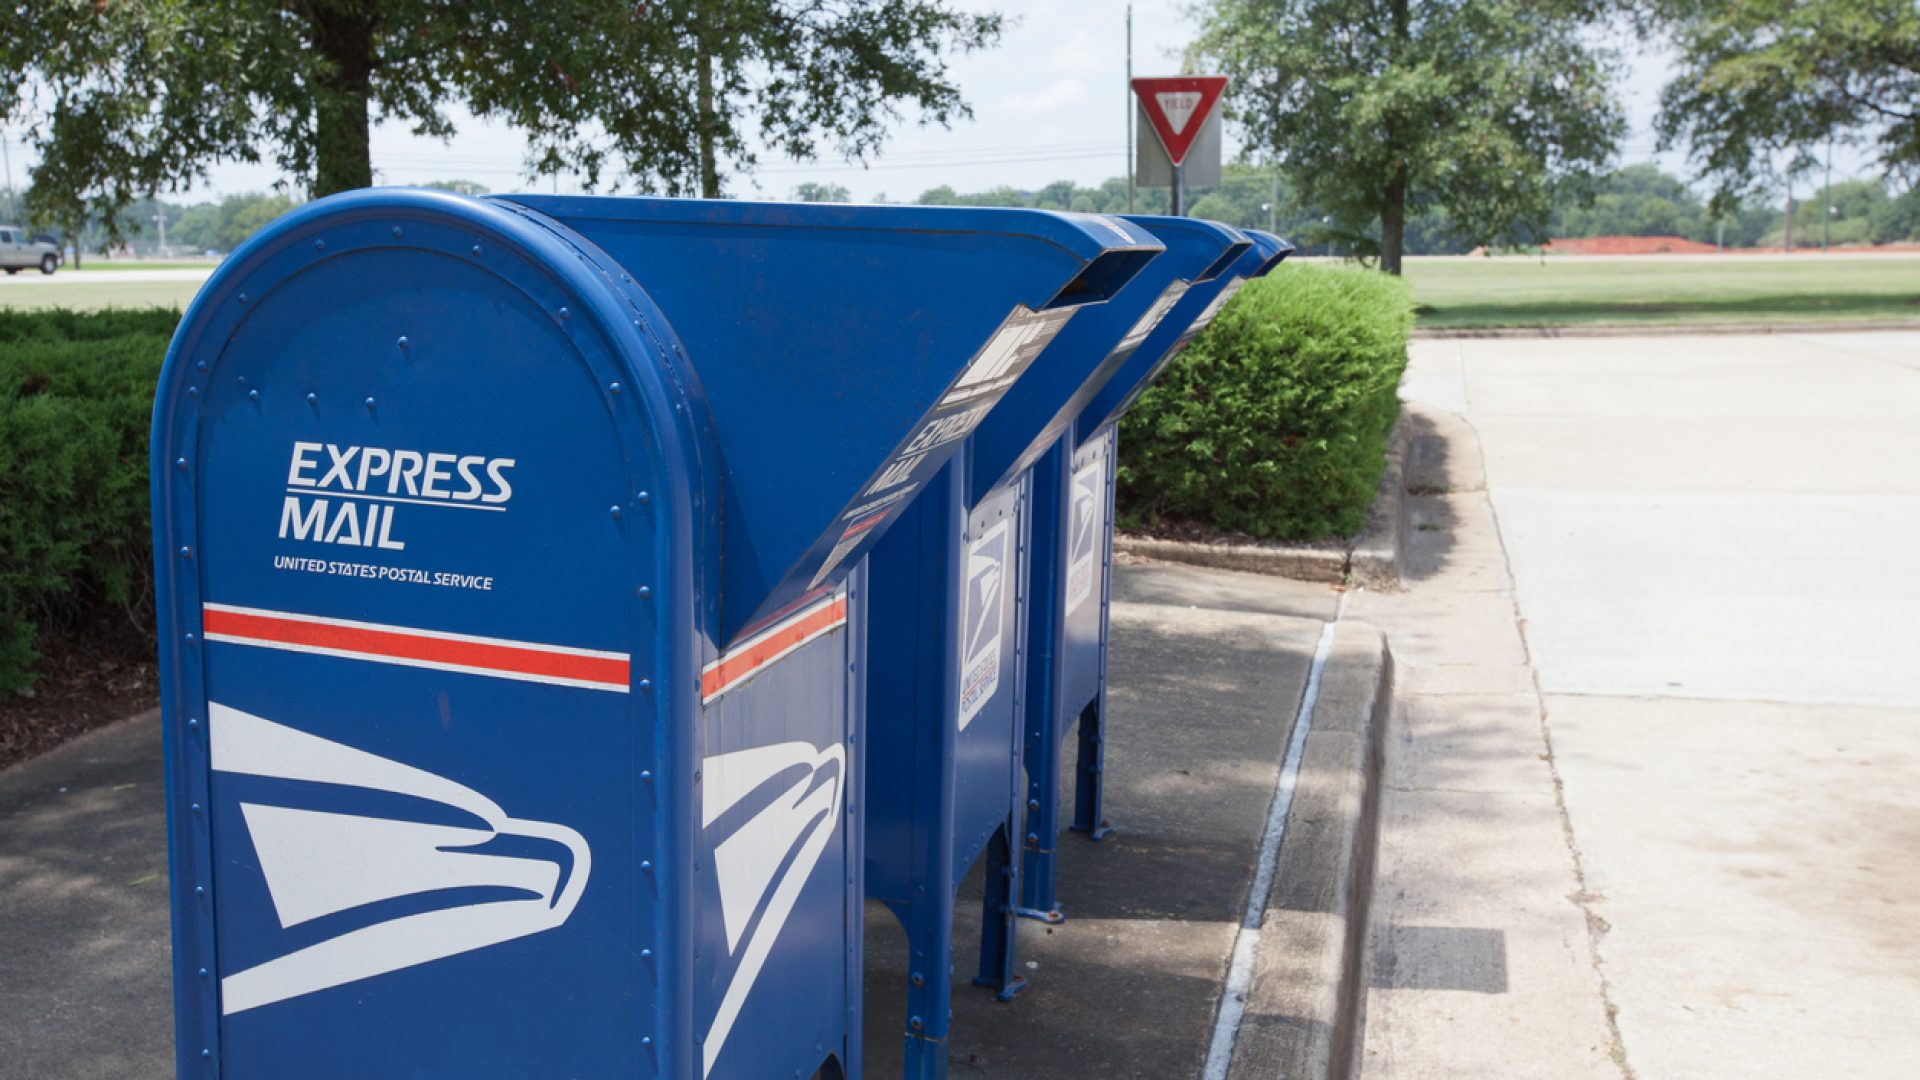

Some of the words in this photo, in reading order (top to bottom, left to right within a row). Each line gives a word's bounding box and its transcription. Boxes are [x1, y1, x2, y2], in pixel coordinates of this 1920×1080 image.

[287, 440, 516, 503] EXPRESS
[278, 496, 406, 551] MAIL
[273, 555, 328, 573] UNITED
[328, 561, 377, 578] STATES
[379, 567, 431, 585] POSTAL
[433, 572, 494, 591] SERVICE
